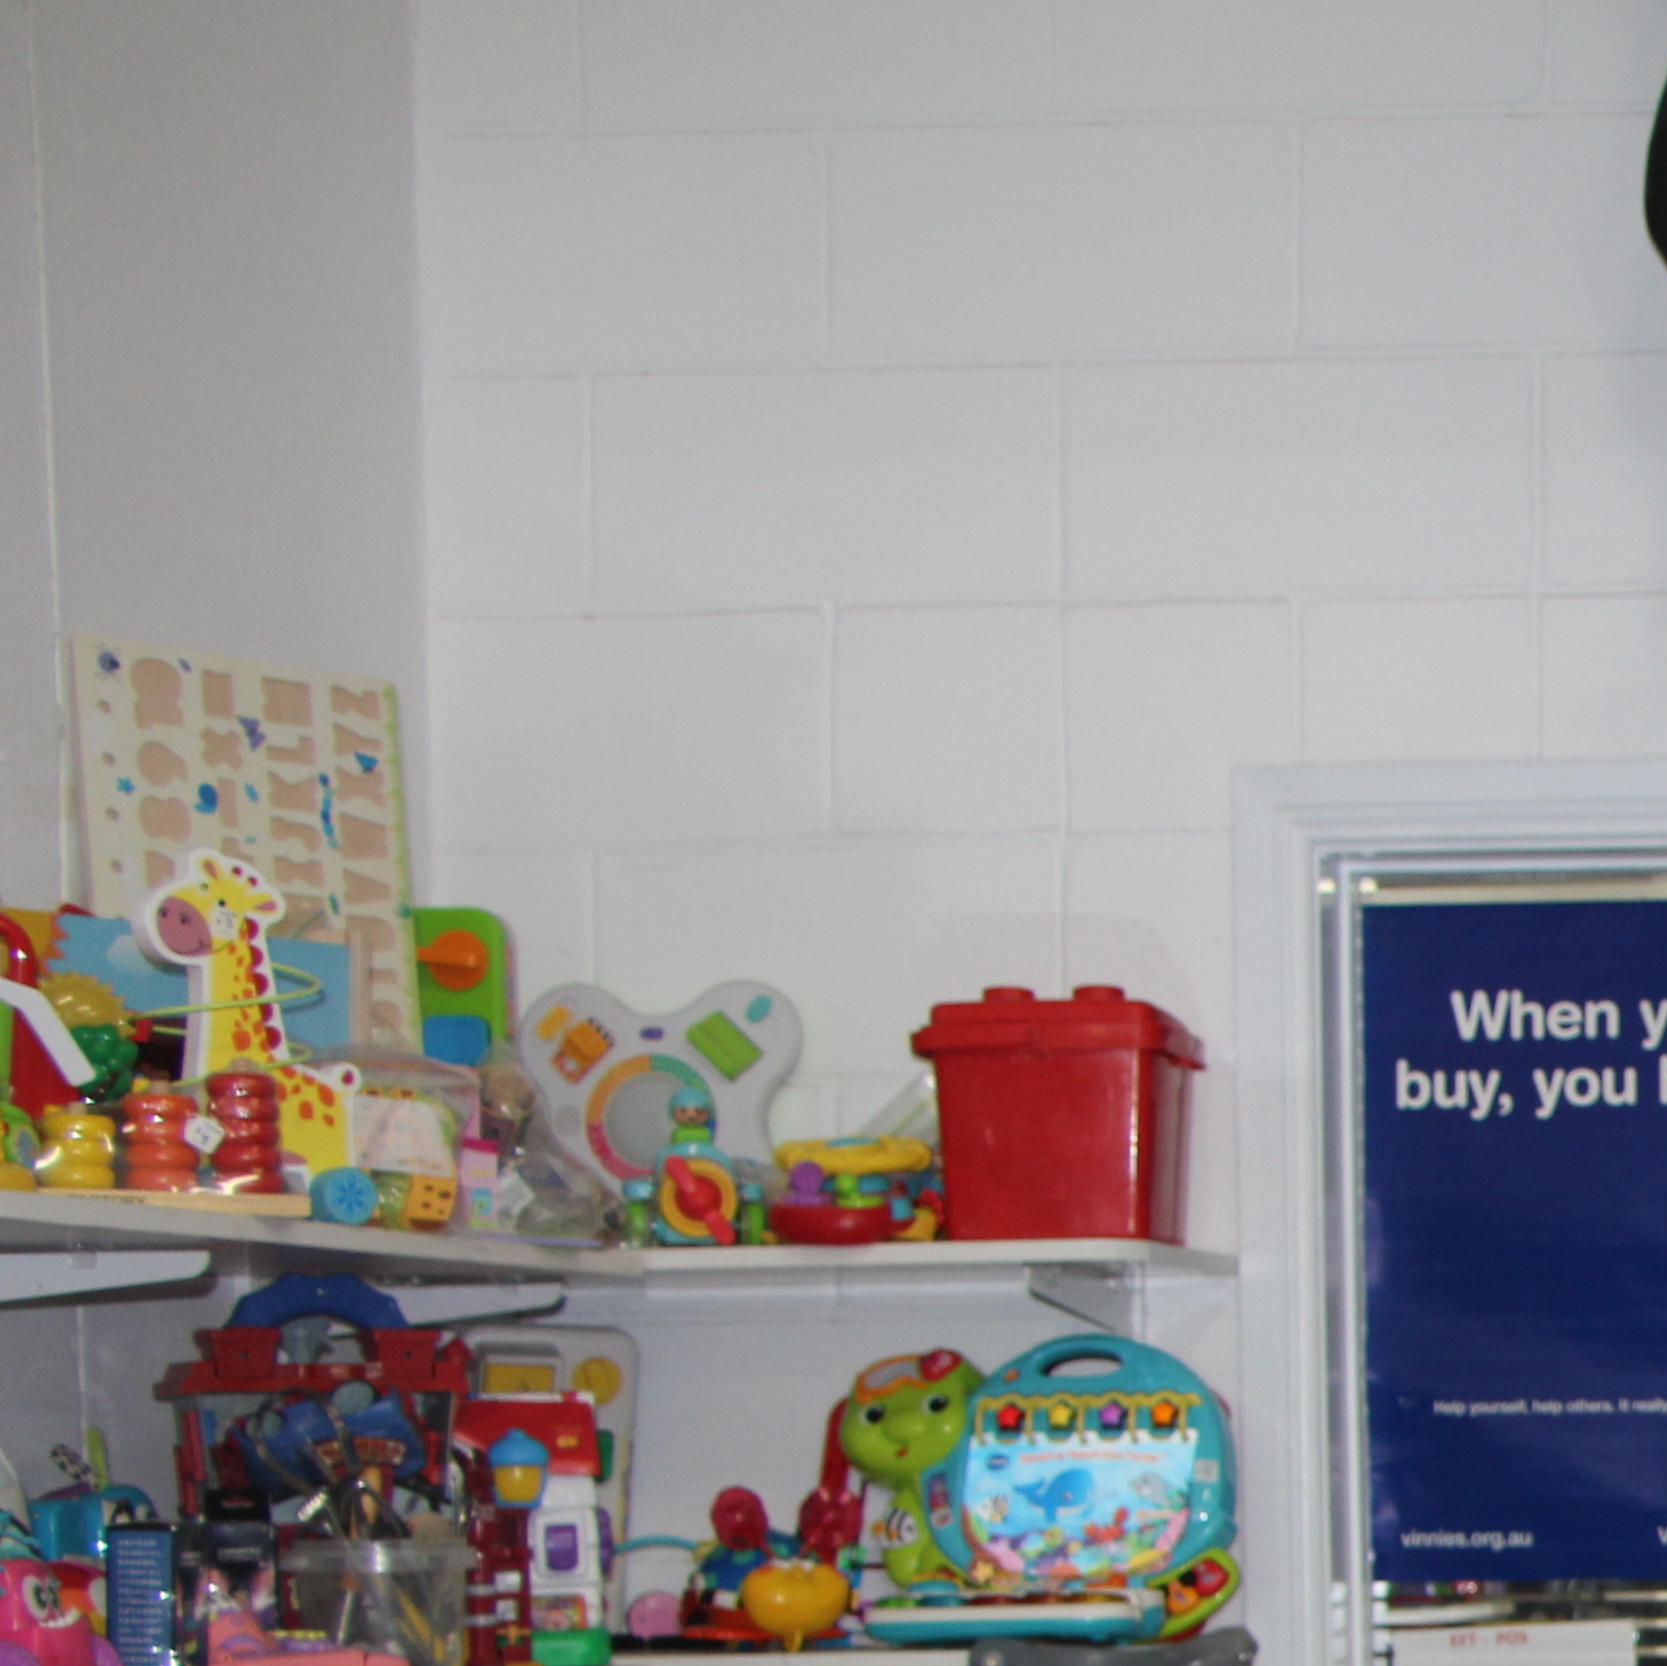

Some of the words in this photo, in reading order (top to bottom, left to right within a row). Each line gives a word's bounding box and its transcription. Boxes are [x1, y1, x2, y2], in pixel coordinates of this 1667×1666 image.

[1450, 991, 1620, 1041] When
[1397, 1060, 1513, 1120] buy,
[1534, 1067, 1637, 1118] you
[1434, 1400, 1465, 1415] Help
[1470, 1400, 1528, 1416] yourself,
[1532, 1400, 1562, 1415] help
[1401, 1530, 1533, 1551] vinnies.org.au
